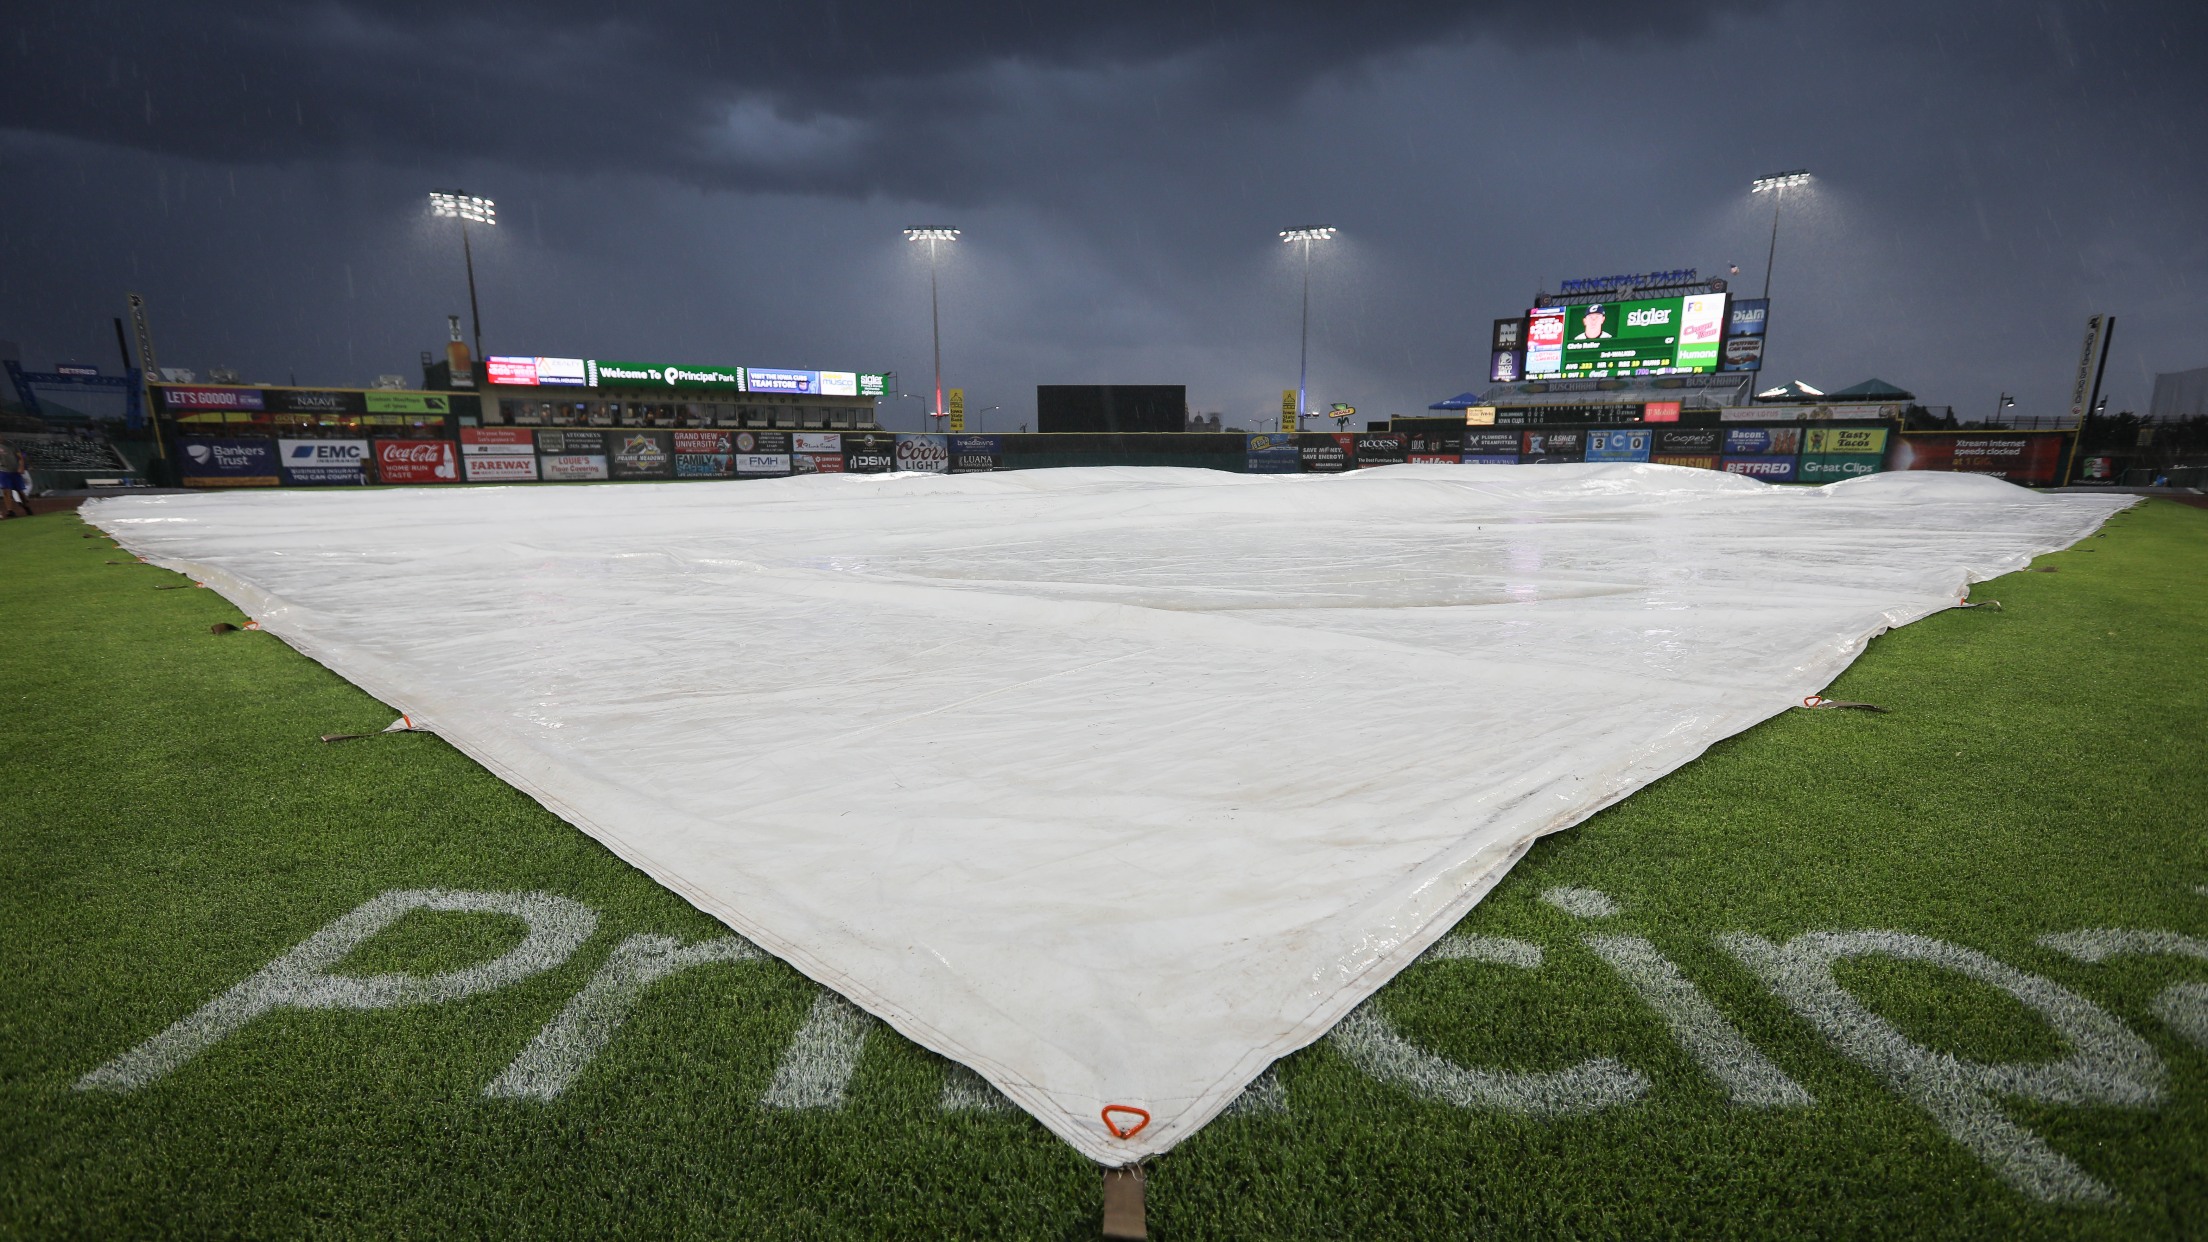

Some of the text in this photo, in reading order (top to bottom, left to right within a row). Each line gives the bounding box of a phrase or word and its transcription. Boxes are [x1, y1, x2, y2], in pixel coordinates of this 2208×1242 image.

[1560, 268, 1697, 289] PRINCIPAL PARK
[1627, 308, 1672, 326] sigler
[1679, 350, 1717, 359] Humana
[599, 367, 735, 383] Welcome To Principal Park
[860, 374, 883, 385] sigler
[751, 379, 797, 389] TEAM STORE
[165, 391, 197, 404] LET'S
[674, 432, 718, 440] GRAND VIEW
[1663, 432, 1715, 445] Cooper's
[1732, 430, 1765, 439] Bacon:
[1838, 431, 1871, 440] Tasty
[675, 440, 716, 448] UNIVERSITY
[1359, 439, 1399, 449] access
[1595, 438, 1603, 449] 3
[1632, 438, 1641, 449] 0
[1837, 439, 1870, 447] Tacos
[1956, 439, 2026, 447] Xtream Internet
[212, 445, 265, 456] Bankers
[317, 445, 360, 458] EMC
[897, 440, 948, 460] Coors
[1954, 447, 2021, 456] speeds clocked
[214, 455, 249, 465] Trust
[558, 456, 590, 465] LOUIE'S
[676, 454, 713, 465] FAMILY
[749, 456, 778, 465] FMH
[858, 456, 891, 466] DSM
[963, 455, 993, 463] LUANA
[1952, 457, 1963, 465] at
[470, 460, 530, 470] FAREWAY
[570, 465, 599, 473] Covering
[905, 461, 940, 470] LIGHT
[1726, 463, 1791, 474] BETFRED
[1804, 461, 1873, 475] Great Clips
